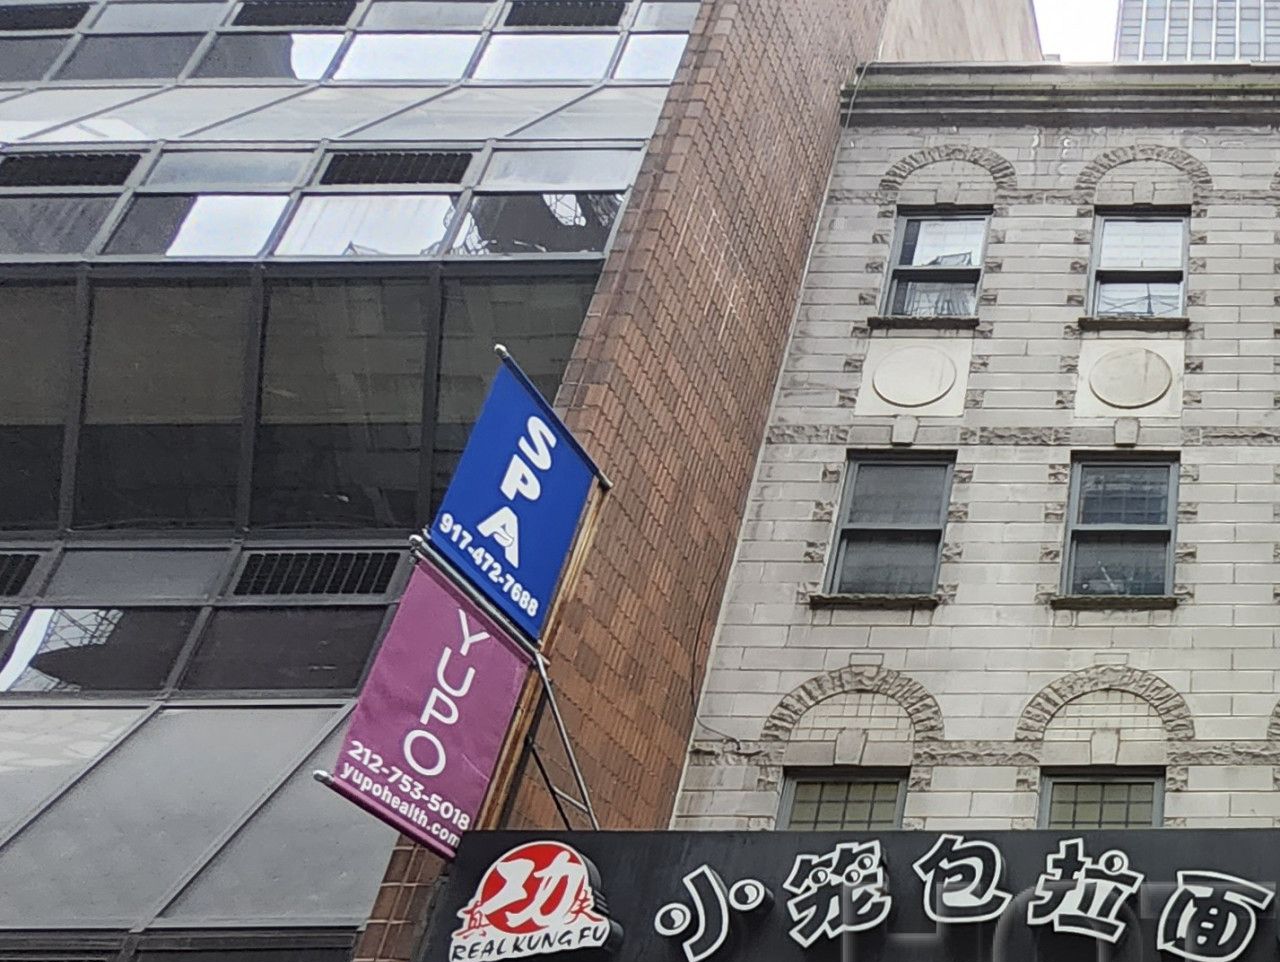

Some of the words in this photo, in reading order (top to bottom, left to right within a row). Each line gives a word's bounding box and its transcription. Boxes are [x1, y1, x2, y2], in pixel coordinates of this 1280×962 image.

[477, 416, 557, 569] SPA
[438, 512, 540, 619] 917-472-7688
[402, 608, 491, 778] YUPO
[339, 762, 462, 849] yupohealth.com
[347, 740, 472, 832] 212-753-5018
[451, 938, 507, 961] REAL
[512, 930, 572, 953] KUNG
[578, 925, 608, 944] FU
